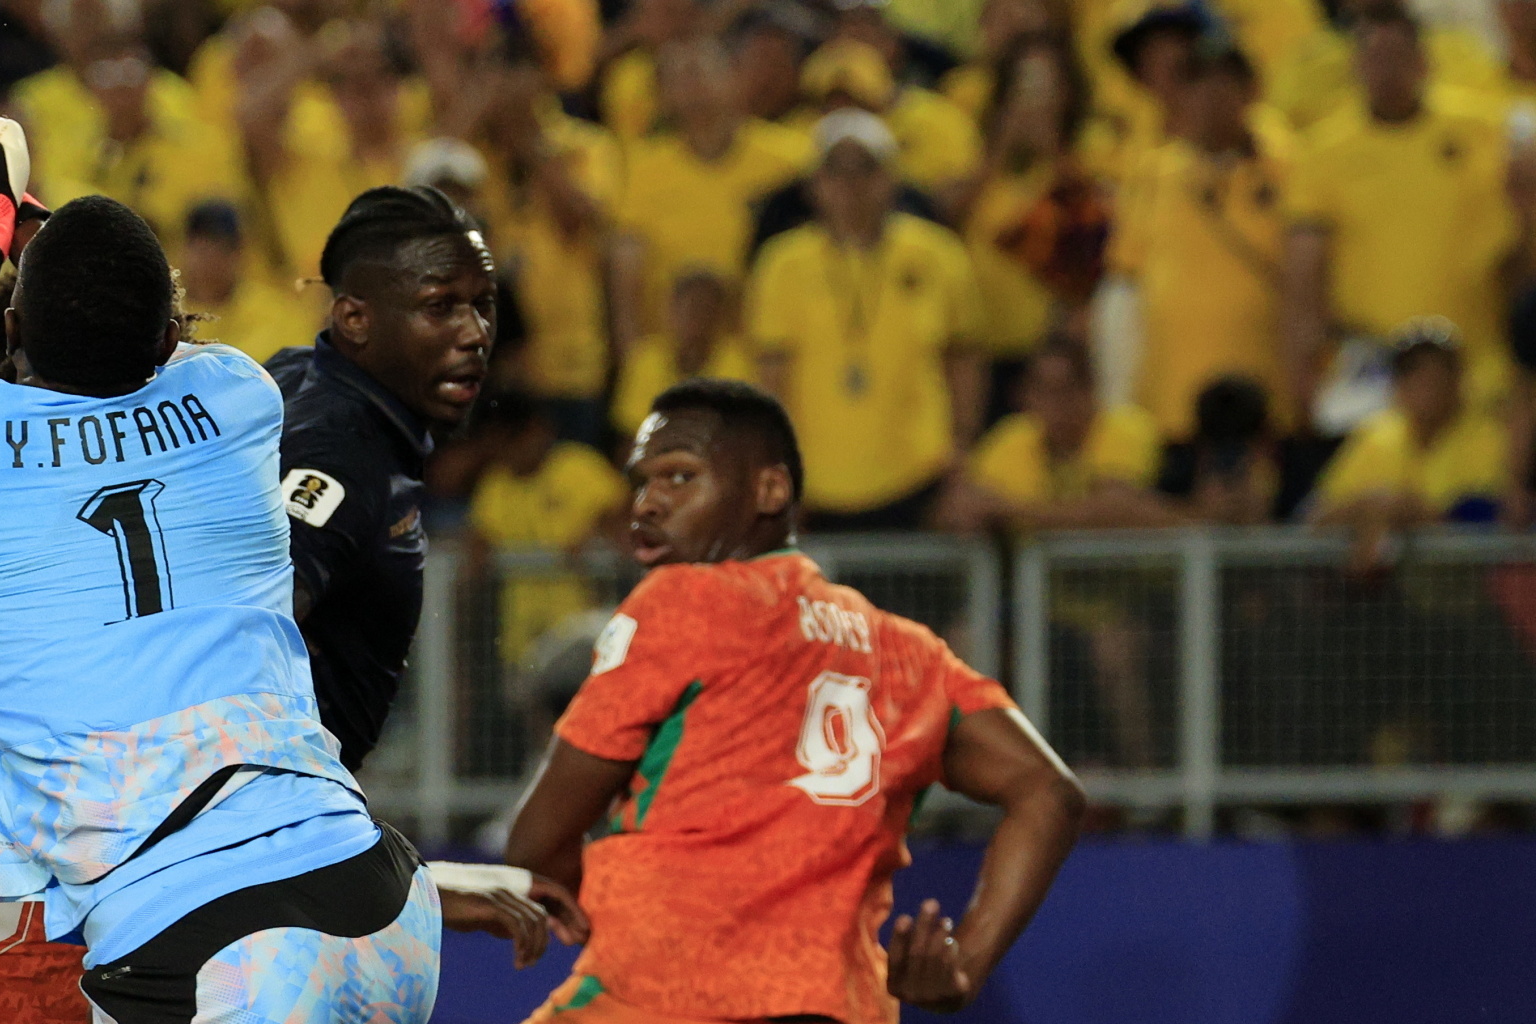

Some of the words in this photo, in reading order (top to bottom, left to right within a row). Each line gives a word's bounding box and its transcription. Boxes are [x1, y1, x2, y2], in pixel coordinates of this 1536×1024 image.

[5, 393, 221, 468] Y.FOFANA
[76, 478, 174, 626] 1
[785, 669, 887, 806] 9
